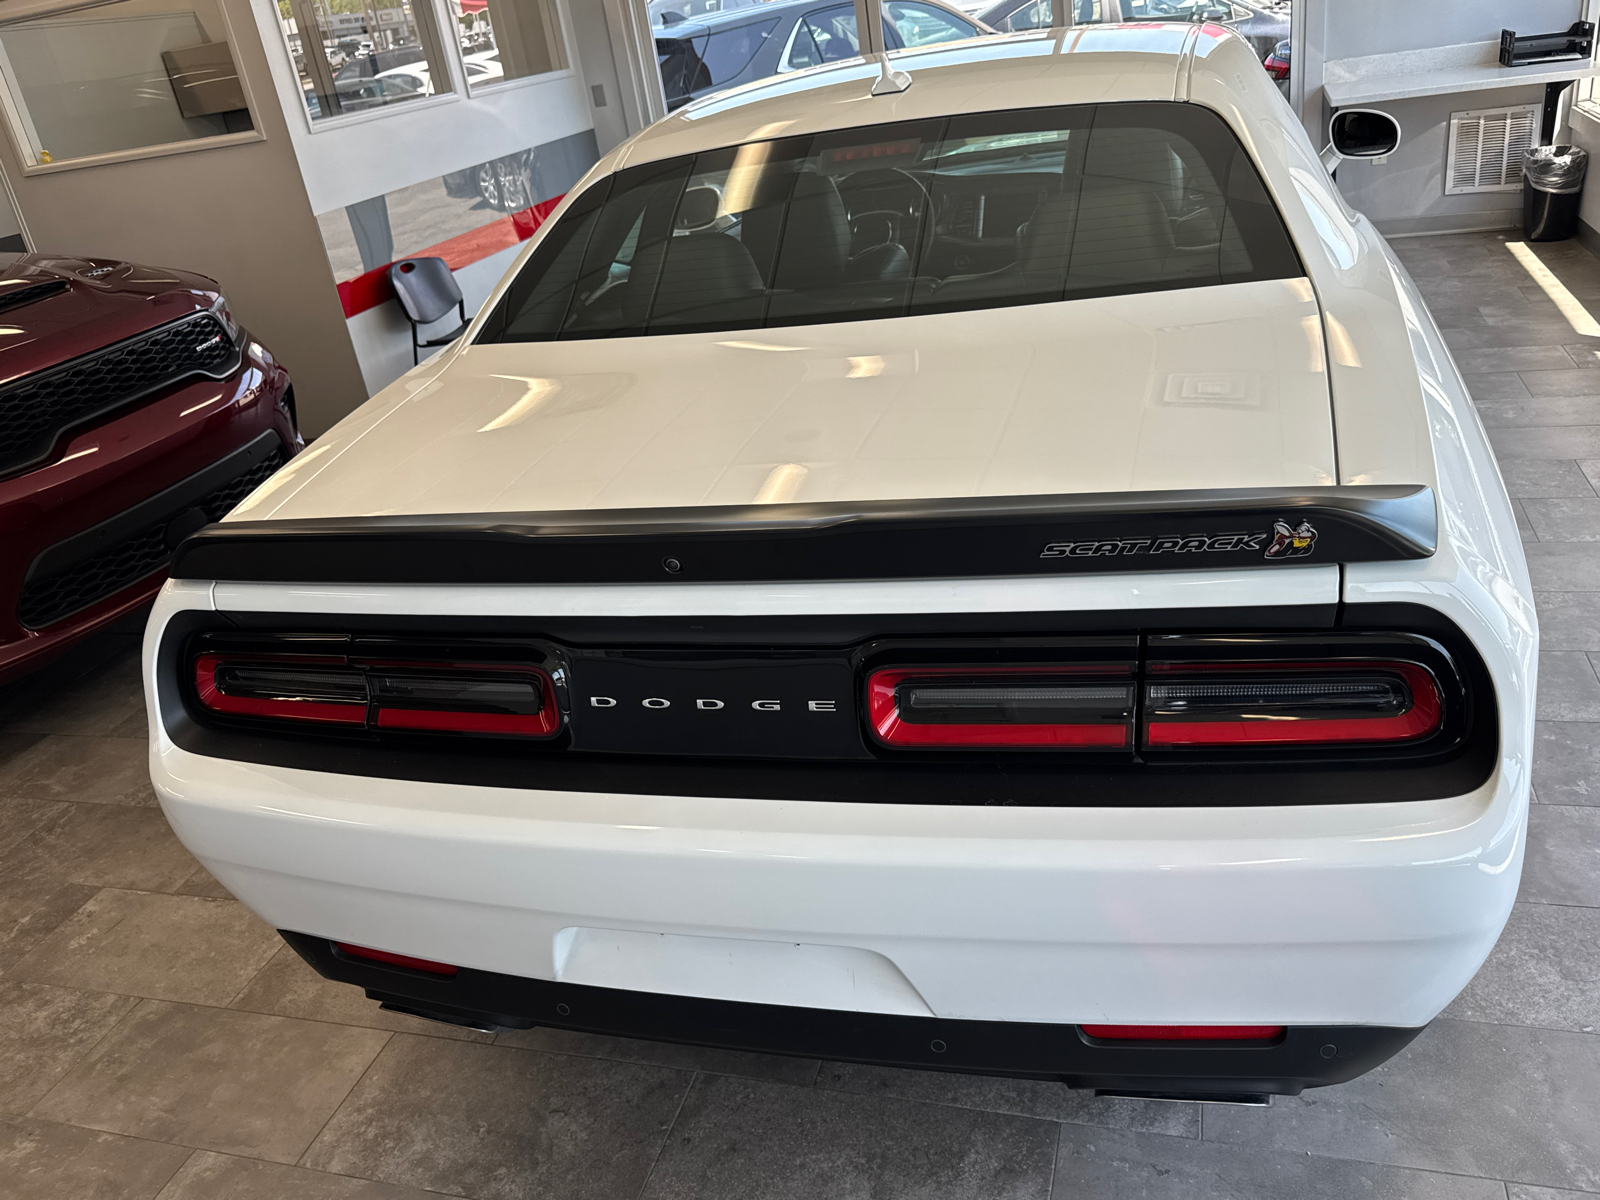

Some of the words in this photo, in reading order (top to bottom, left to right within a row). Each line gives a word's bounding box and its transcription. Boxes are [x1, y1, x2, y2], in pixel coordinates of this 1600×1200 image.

[1040, 538, 1150, 558] SCAT
[1150, 531, 1267, 554] PACK
[590, 696, 836, 712] DODGE
